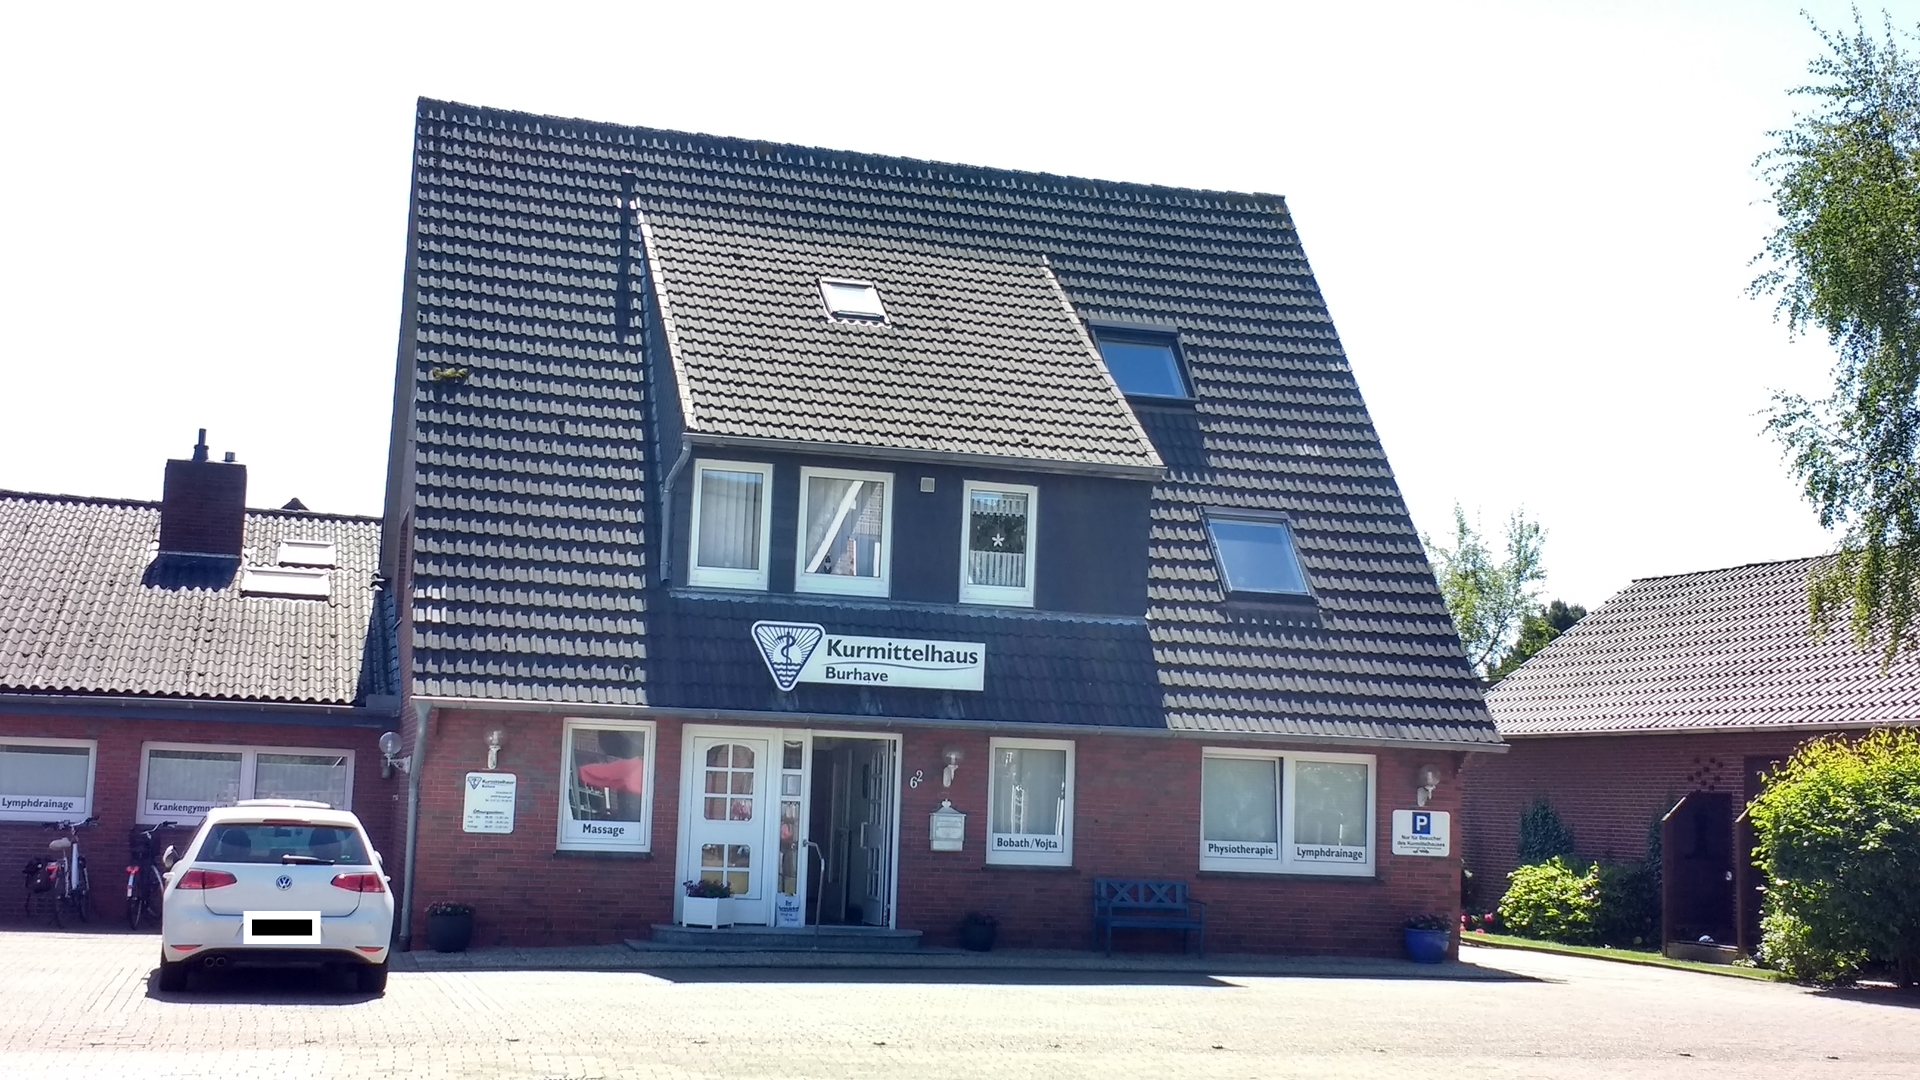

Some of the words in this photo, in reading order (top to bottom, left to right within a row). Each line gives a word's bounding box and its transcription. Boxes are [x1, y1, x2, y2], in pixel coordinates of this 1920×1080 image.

[826, 638, 979, 665] Kurmittelhaus
[825, 666, 889, 682] Burhave
[2, 797, 74, 811] Lymphdrainage
[153, 802, 228, 814] Krankengymn
[582, 823, 625, 837] Massage
[1416, 815, 1428, 831] P
[996, 837, 1058, 850] Bobath/Vojta
[1208, 843, 1274, 857] Physiotherapie
[1296, 846, 1363, 861] Lymphdrainage
